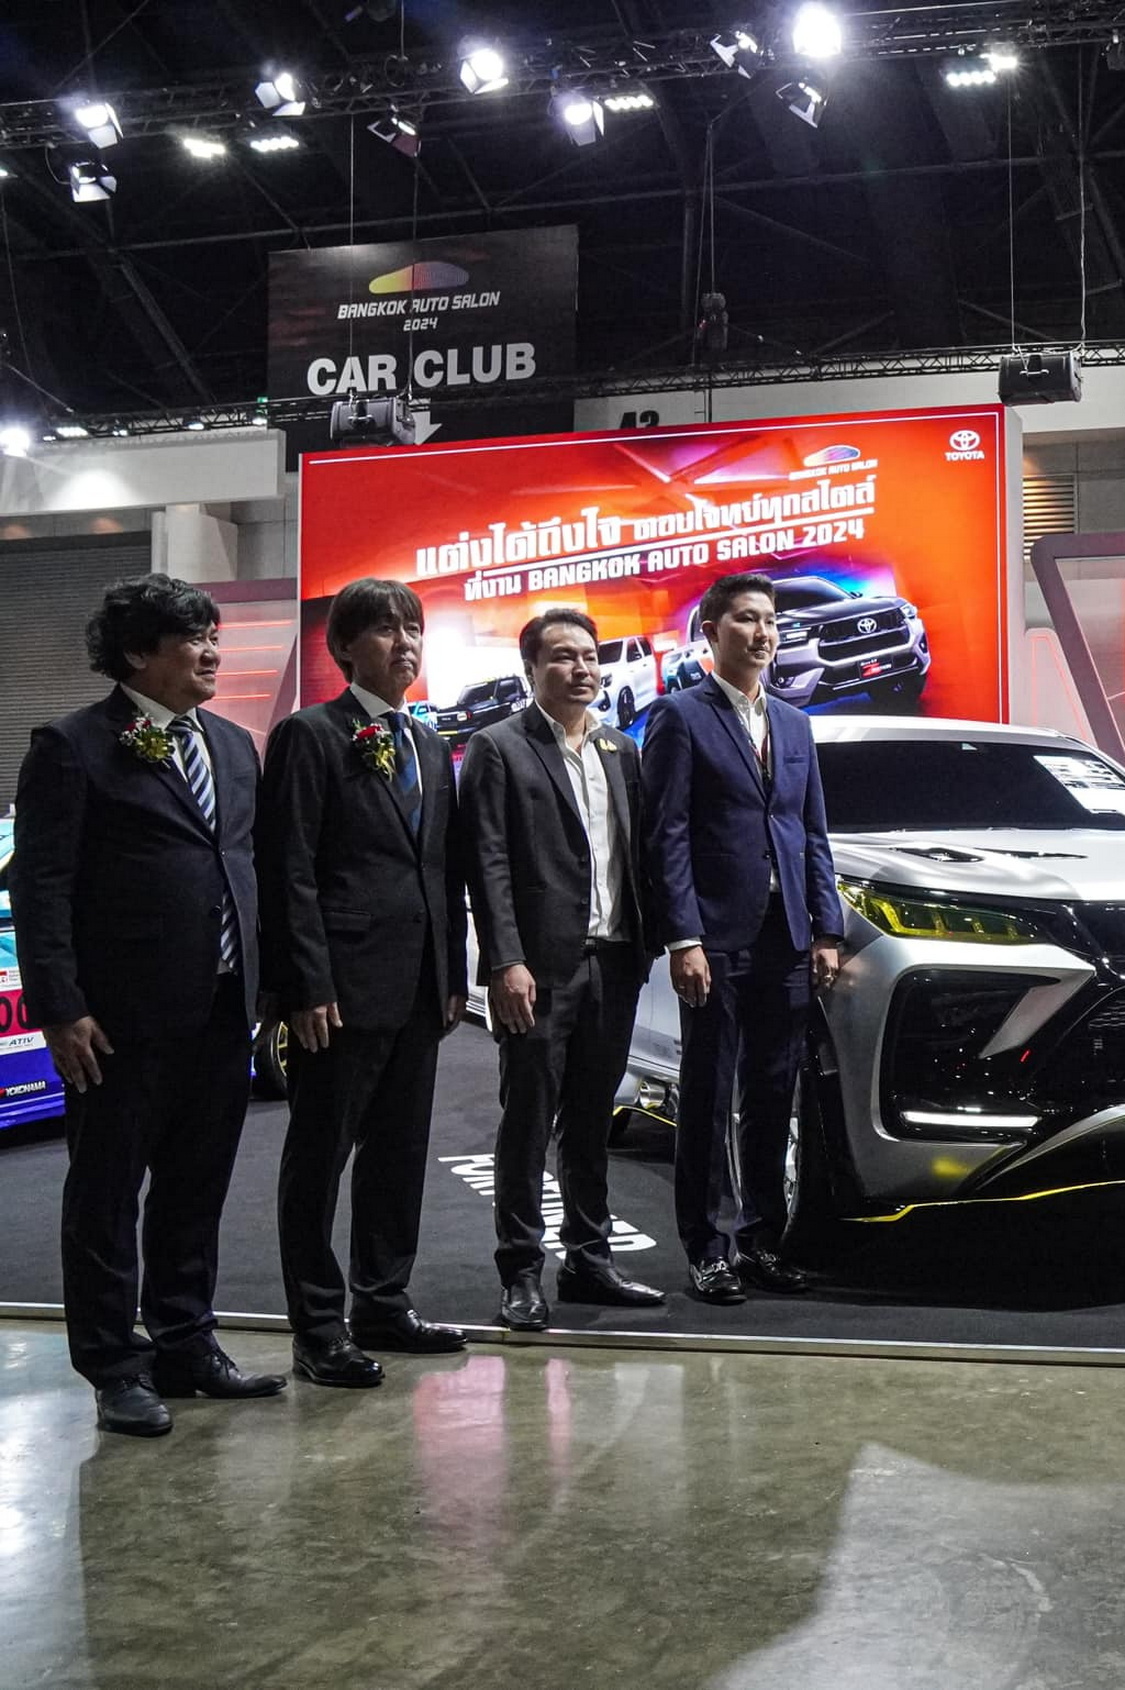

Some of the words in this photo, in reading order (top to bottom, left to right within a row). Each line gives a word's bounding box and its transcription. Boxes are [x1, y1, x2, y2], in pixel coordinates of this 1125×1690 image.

[337, 300, 406, 319] BANGKOK
[411, 297, 449, 313] AUTO
[451, 291, 501, 310] SALON
[403, 317, 438, 331] 2024
[307, 354, 397, 396] CAR
[413, 342, 537, 388] CLUB
[945, 450, 985, 461] TOYOTA
[528, 553, 641, 591] BANGKOK
[648, 542, 710, 572] AUTO
[716, 529, 795, 560] SALON
[802, 518, 865, 548] 2024
